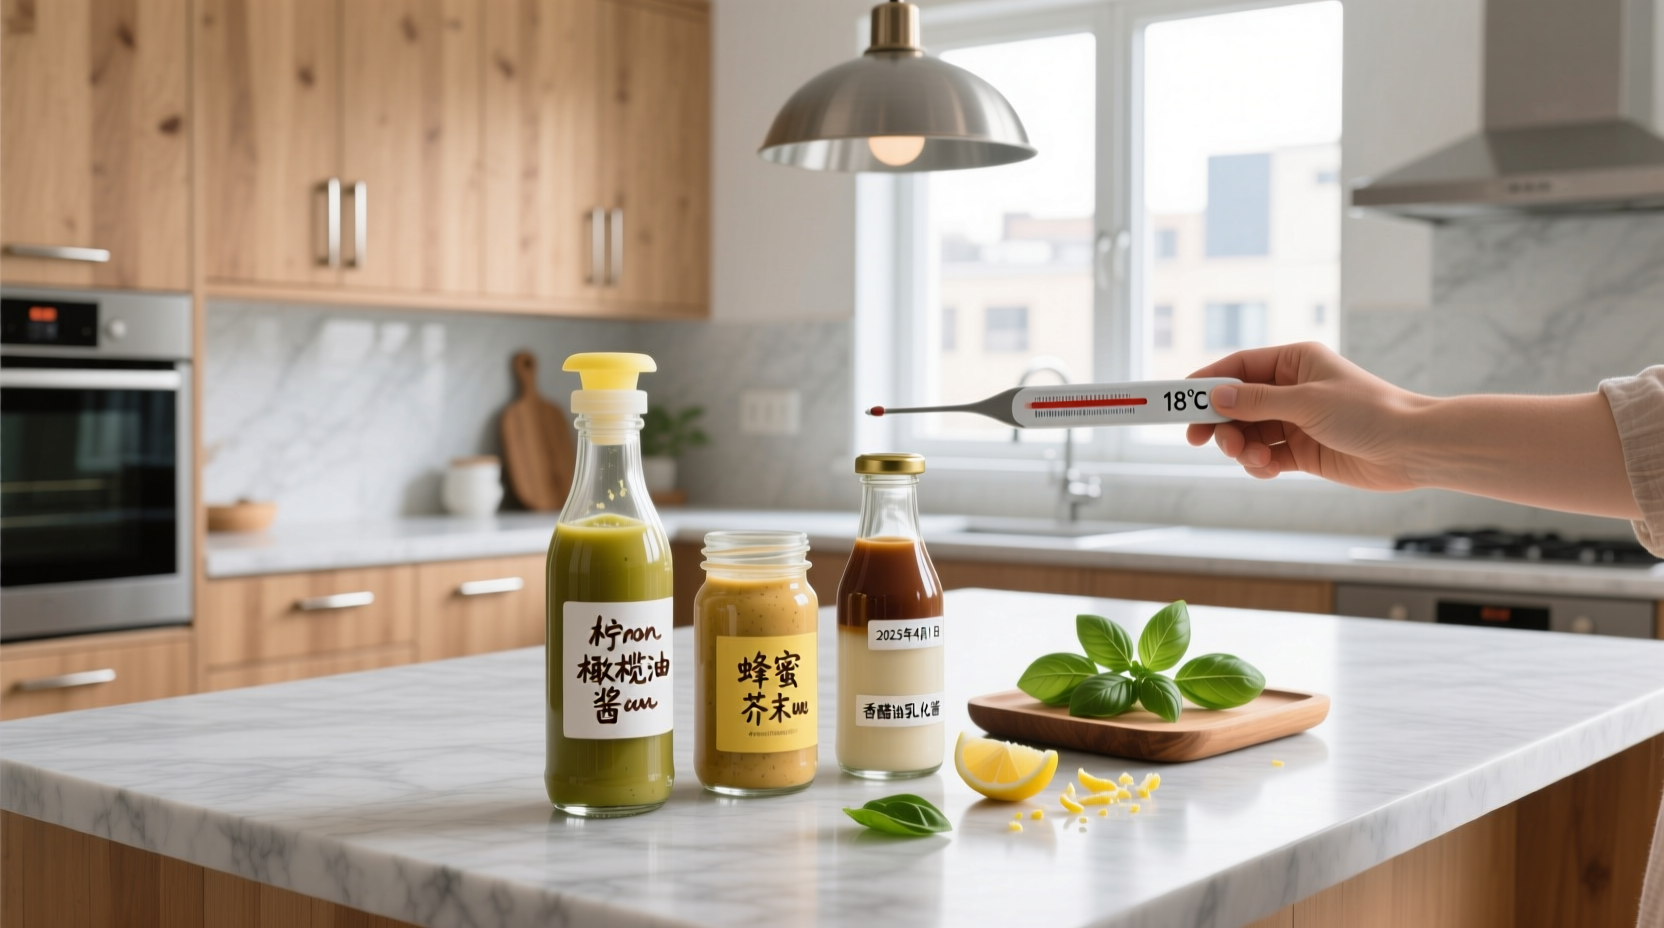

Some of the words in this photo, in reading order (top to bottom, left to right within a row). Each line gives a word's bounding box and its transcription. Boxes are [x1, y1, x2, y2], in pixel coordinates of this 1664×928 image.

[576, 650, 670, 686] 橄榄油
[737, 649, 801, 689] 蜂蜜
